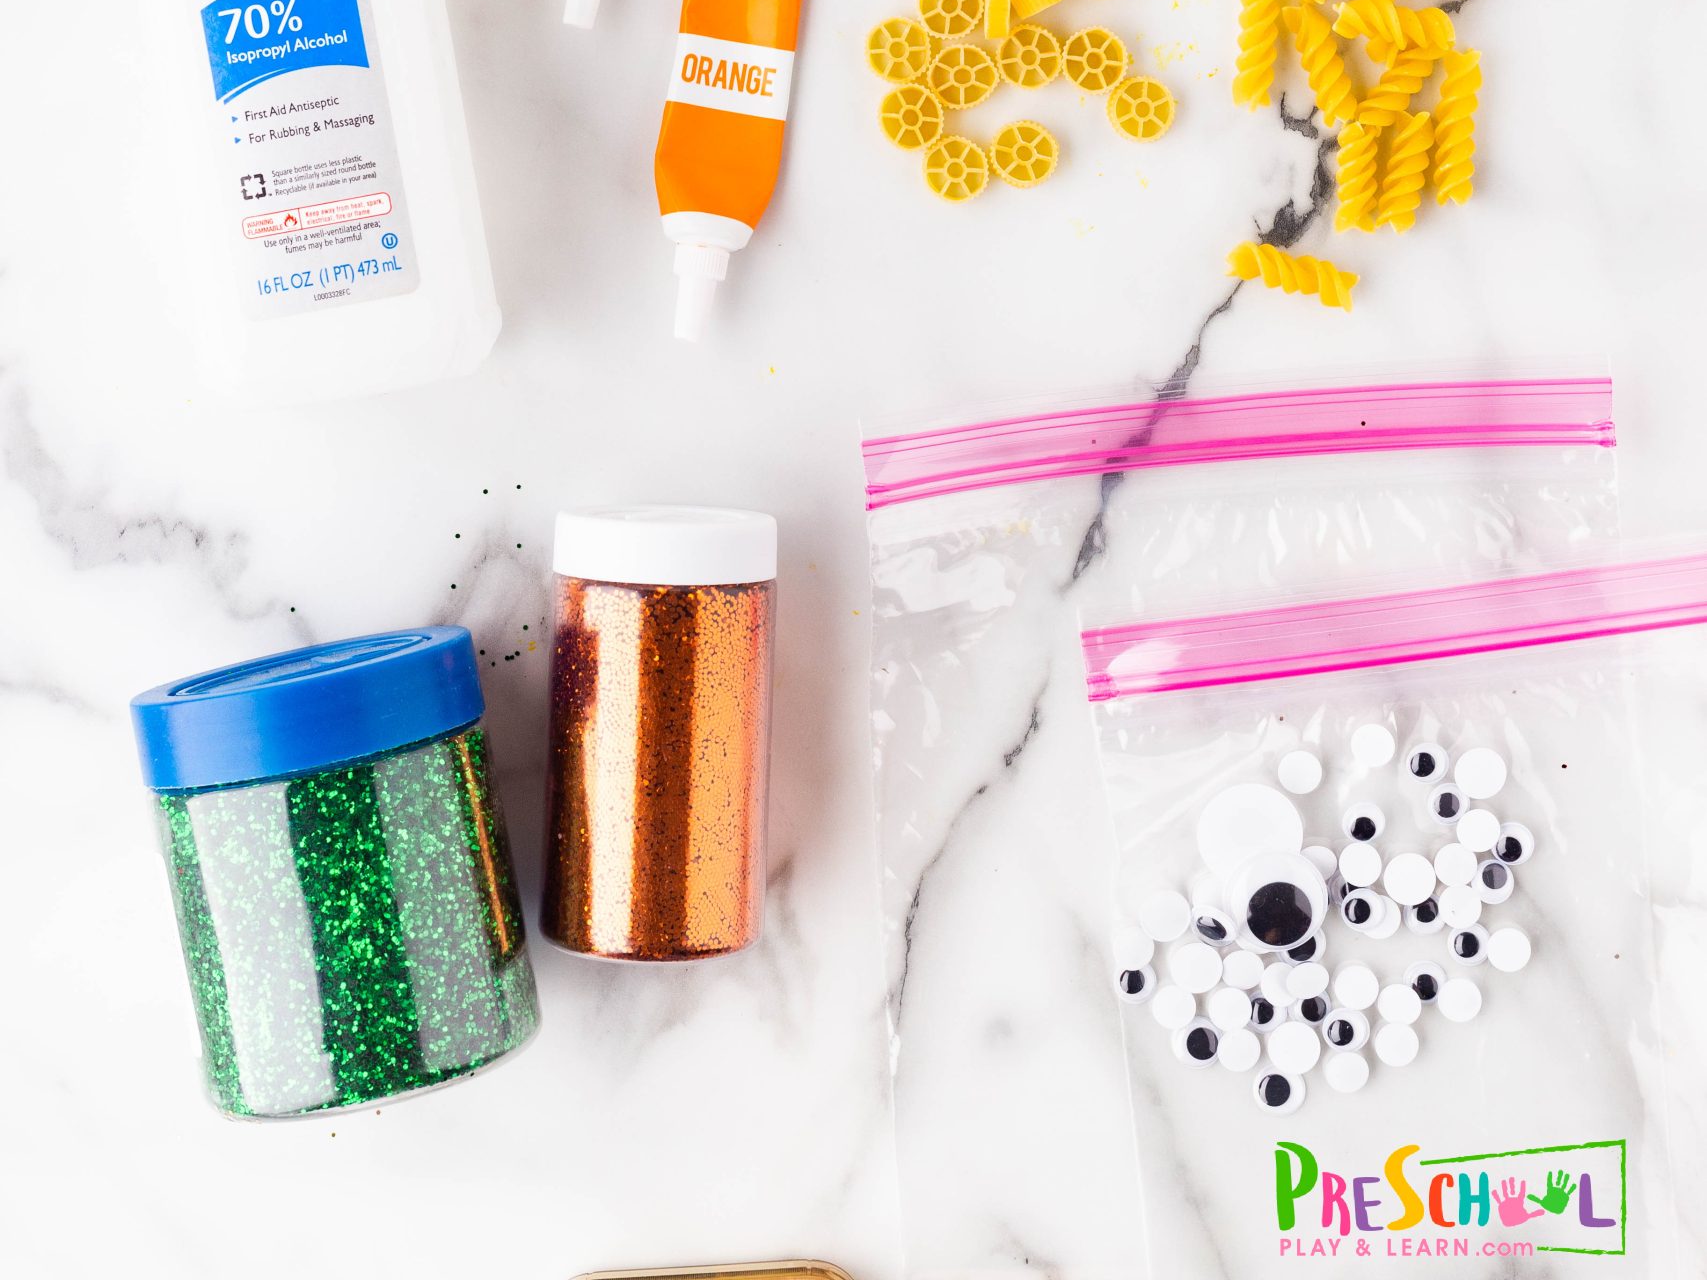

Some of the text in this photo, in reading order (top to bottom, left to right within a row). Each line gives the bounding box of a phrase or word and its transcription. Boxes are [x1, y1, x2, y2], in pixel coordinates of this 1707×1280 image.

[227, 30, 348, 64] Isopropyl Alcohol
[680, 53, 777, 98] ORANGE
[245, 96, 340, 122] First Aid Antiseptic
[249, 114, 374, 144] For Rubbing & Massaging
[272, 169, 292, 178] Square
[294, 164, 312, 174] bottle
[329, 159, 340, 168] less
[342, 155, 362, 166] plastic
[273, 177, 288, 186] than
[294, 170, 320, 182] similarly
[321, 168, 336, 177] sized
[338, 165, 356, 174] round
[358, 161, 376, 171] bottle
[275, 184, 306, 196] Recyclable
[316, 178, 340, 190] available
[349, 175, 360, 186] your
[362, 171, 376, 181] area)
[246, 217, 274, 228] WARNING
[248, 224, 284, 236] FLAMMABLE
[264, 239, 277, 248] Use
[279, 235, 294, 246] only
[295, 234, 302, 242] in
[310, 223, 362, 238] well-ventilated
[363, 220, 381, 230] area;
[285, 232, 362, 254] fumes may be harmful
[258, 279, 272, 295] 16
[273, 276, 288, 292] FL
[291, 271, 314, 288] OZ
[333, 263, 355, 283] PT)
[358, 259, 378, 276] 473
[382, 255, 402, 272] mL
